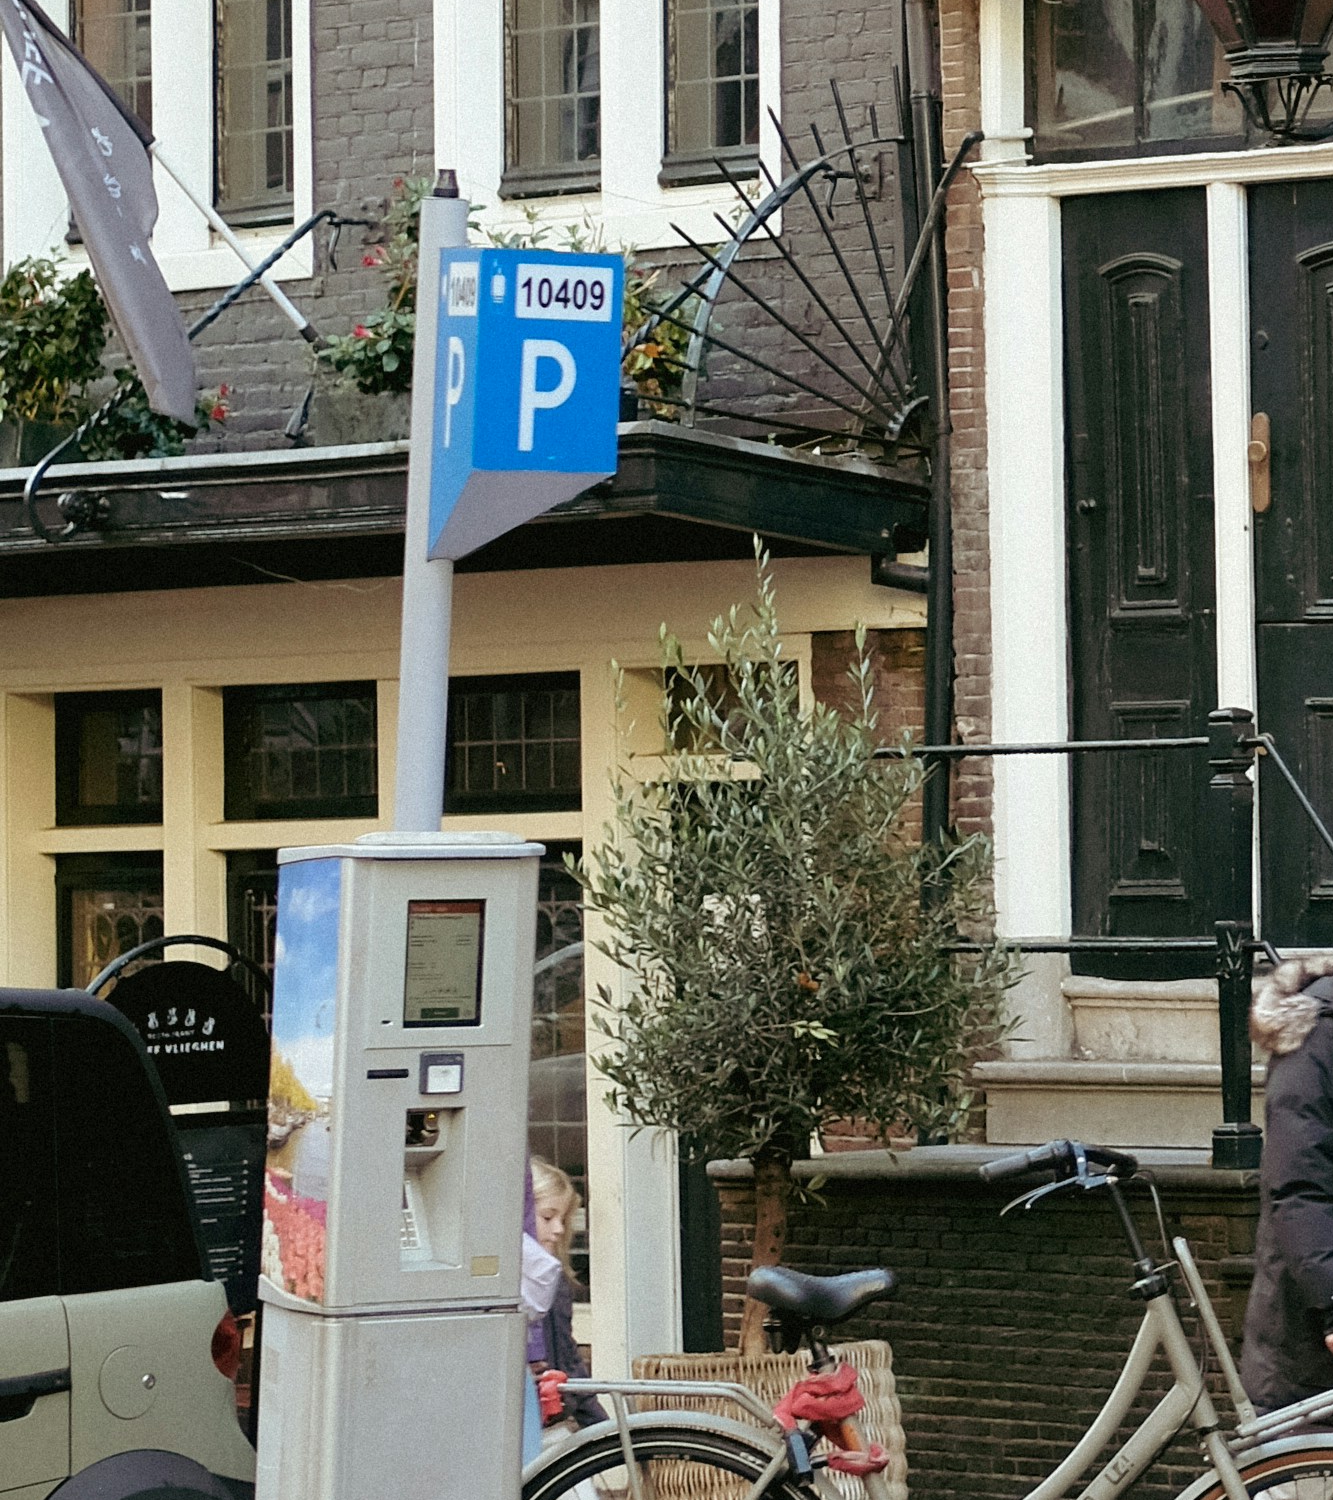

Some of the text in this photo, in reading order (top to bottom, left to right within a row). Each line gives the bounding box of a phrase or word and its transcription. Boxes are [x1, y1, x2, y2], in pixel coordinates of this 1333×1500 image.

[521, 276, 606, 311] 10409
[517, 338, 577, 452] P
[164, 1039, 225, 1055] VLIEGHEN
